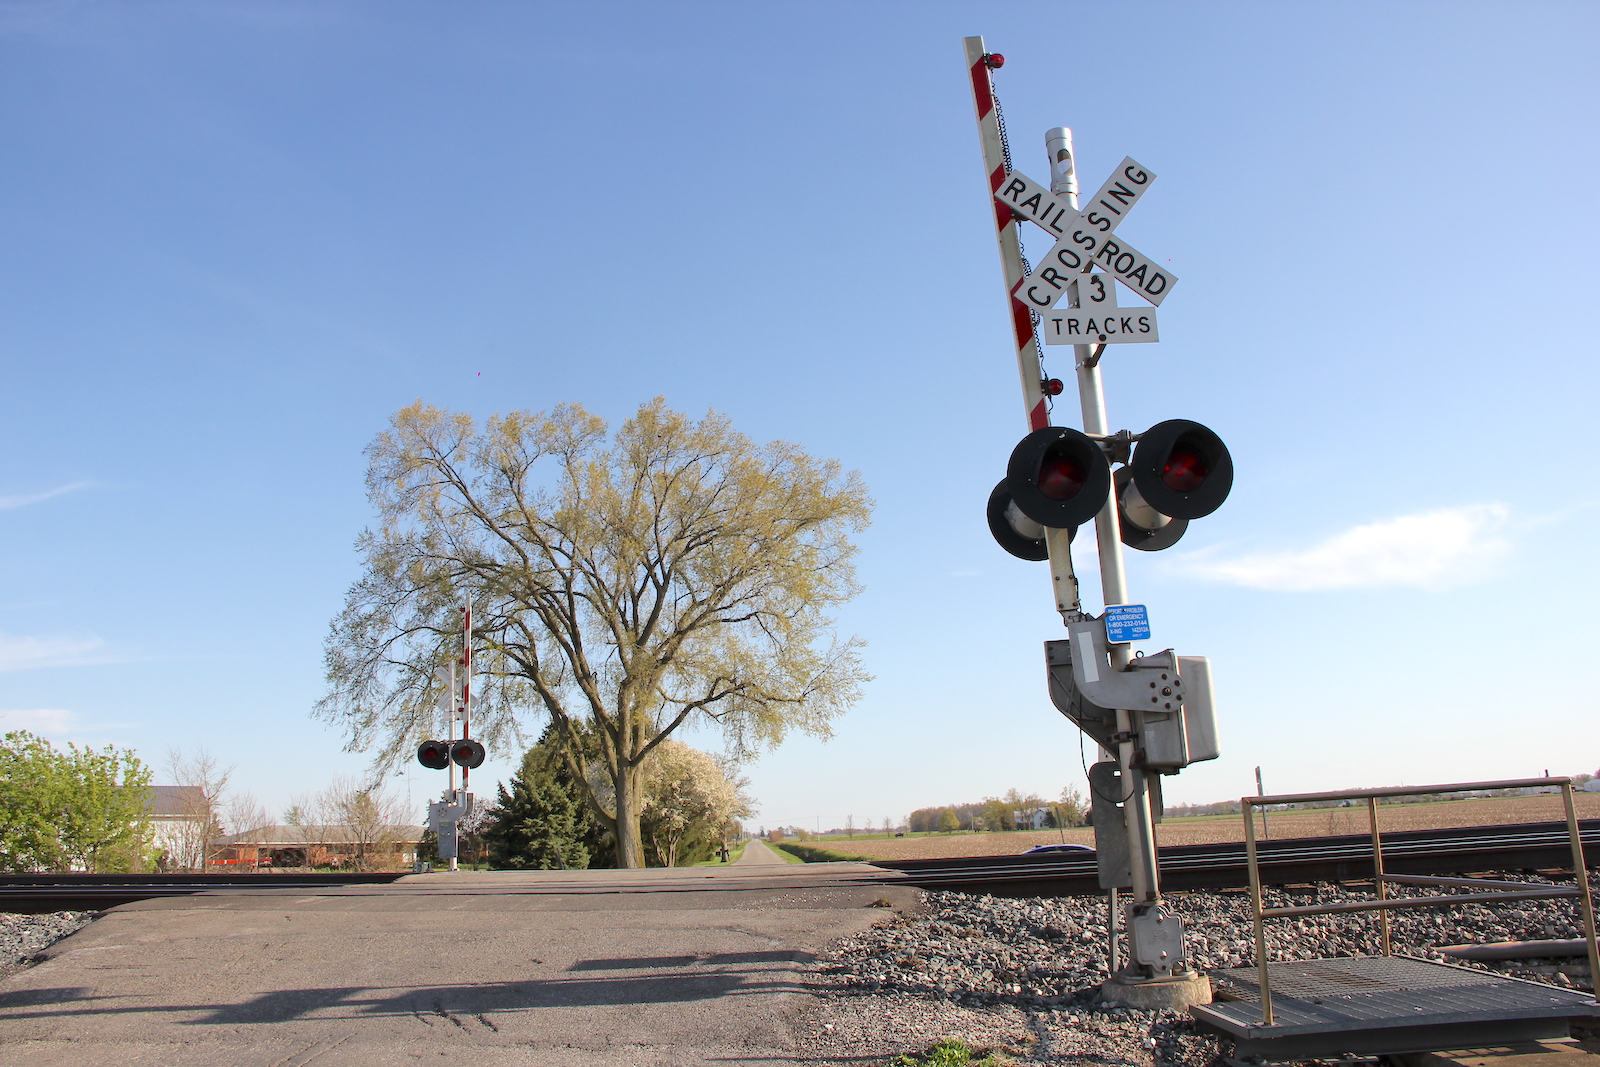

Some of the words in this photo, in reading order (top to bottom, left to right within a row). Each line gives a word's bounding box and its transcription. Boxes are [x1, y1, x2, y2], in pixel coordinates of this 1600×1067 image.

[1002, 177, 1066, 234] RAIL
[1096, 239, 1167, 296] ROAD
[1027, 165, 1148, 307] CROSSING
[1090, 275, 1106, 303] 3
[1051, 316, 1150, 336] TRACKS
